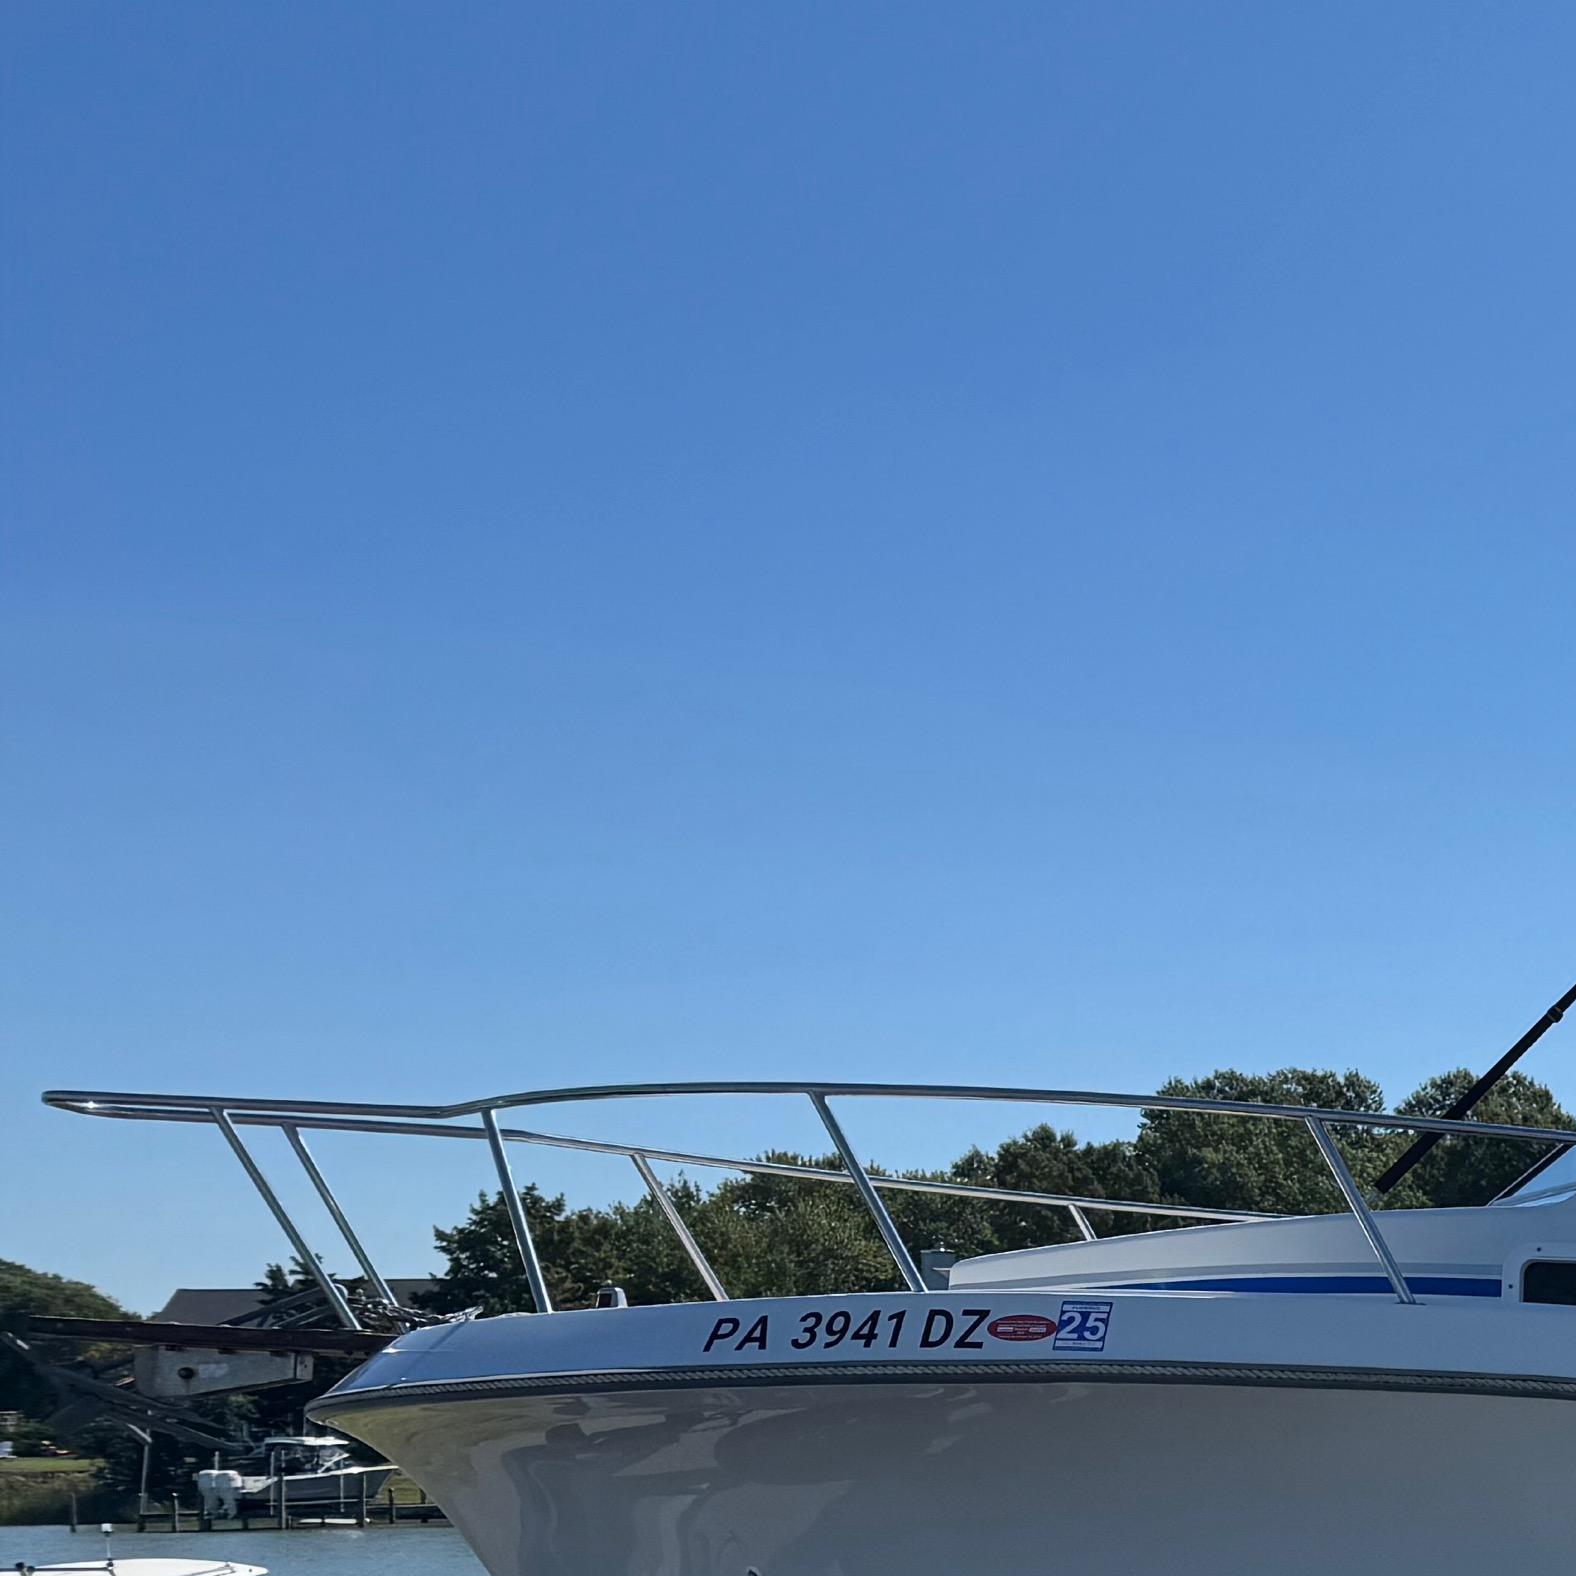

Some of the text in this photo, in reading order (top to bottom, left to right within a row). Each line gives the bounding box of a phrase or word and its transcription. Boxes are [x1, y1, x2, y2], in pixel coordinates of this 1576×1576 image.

[702, 1314, 769, 1352] PA
[790, 1309, 907, 1350] 3941
[919, 1308, 992, 1350] DZ
[1056, 1311, 1108, 1341] 25
